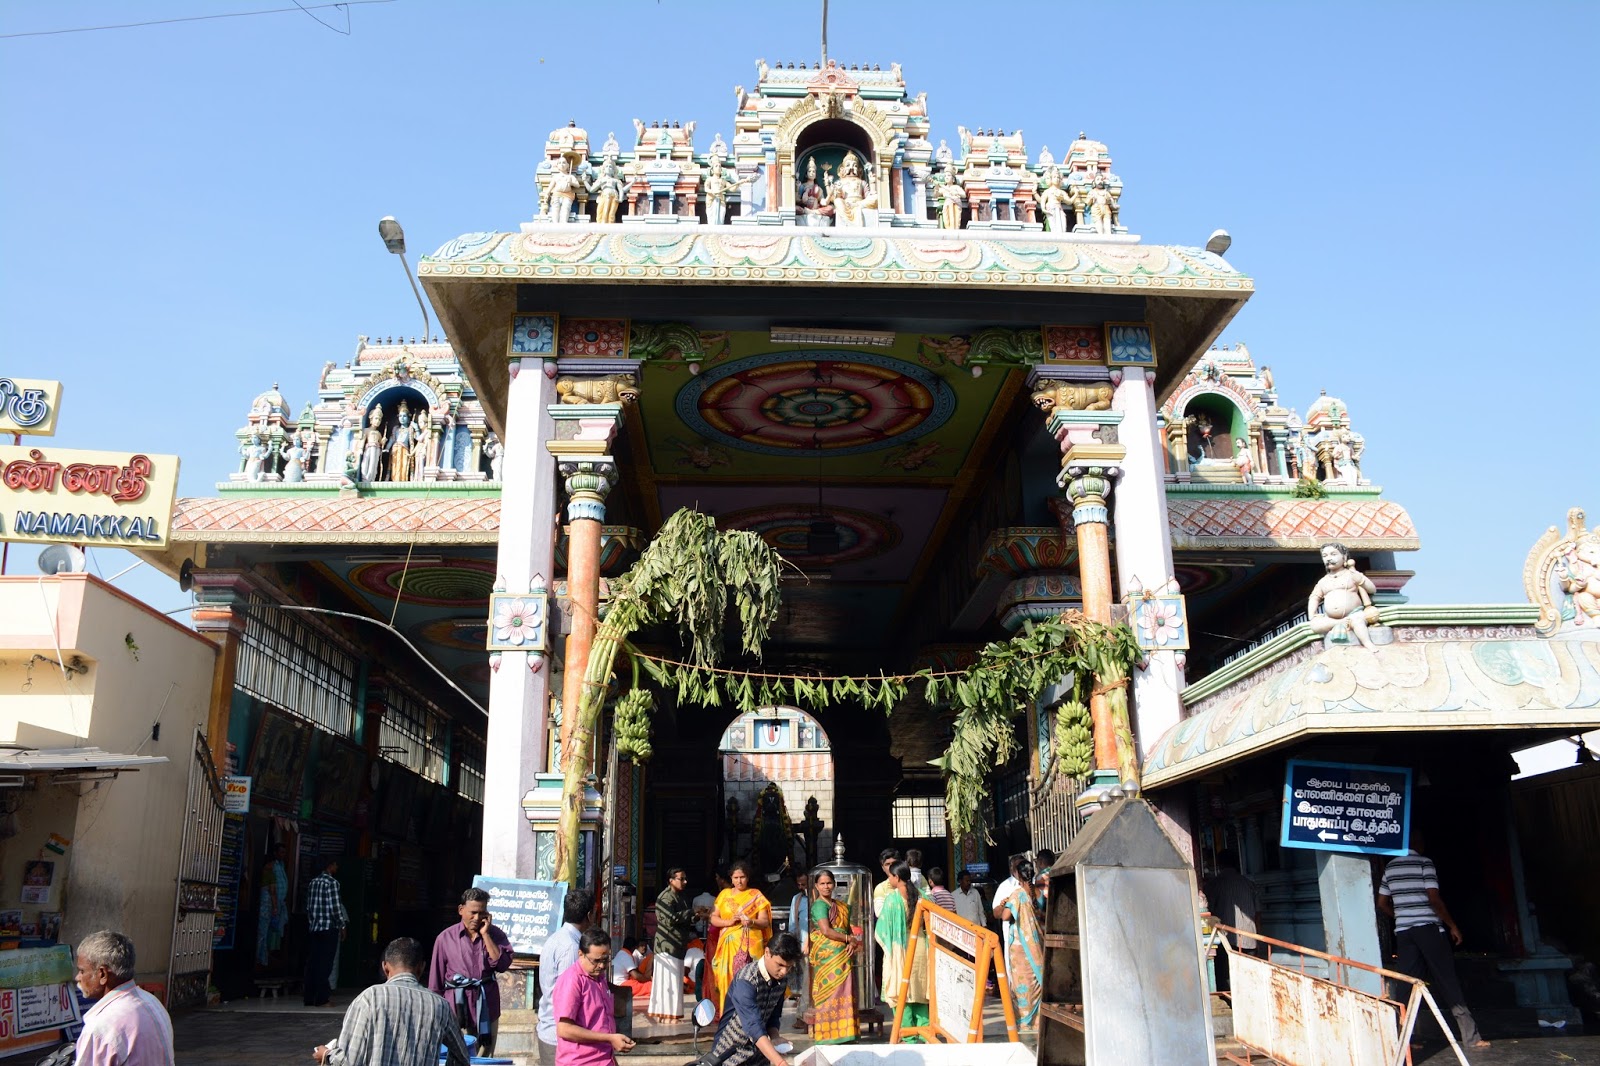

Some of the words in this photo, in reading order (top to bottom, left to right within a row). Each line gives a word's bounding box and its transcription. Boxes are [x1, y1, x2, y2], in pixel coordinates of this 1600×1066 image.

[0, 449, 152, 503] ன்னதி
[14, 510, 160, 541] NAMAKKAL
[1307, 778, 1342, 788] ஆலய
[1346, 783, 1390, 792] படிகளில்
[1295, 789, 1364, 802] காலணிகளை
[1366, 793, 1401, 807] விடாதீர்
[1298, 801, 1344, 814] இலவச
[1346, 807, 1393, 818] காலணி
[1293, 815, 1349, 831] பாதுகாப்பு
[1351, 819, 1400, 835] இடத்தில்
